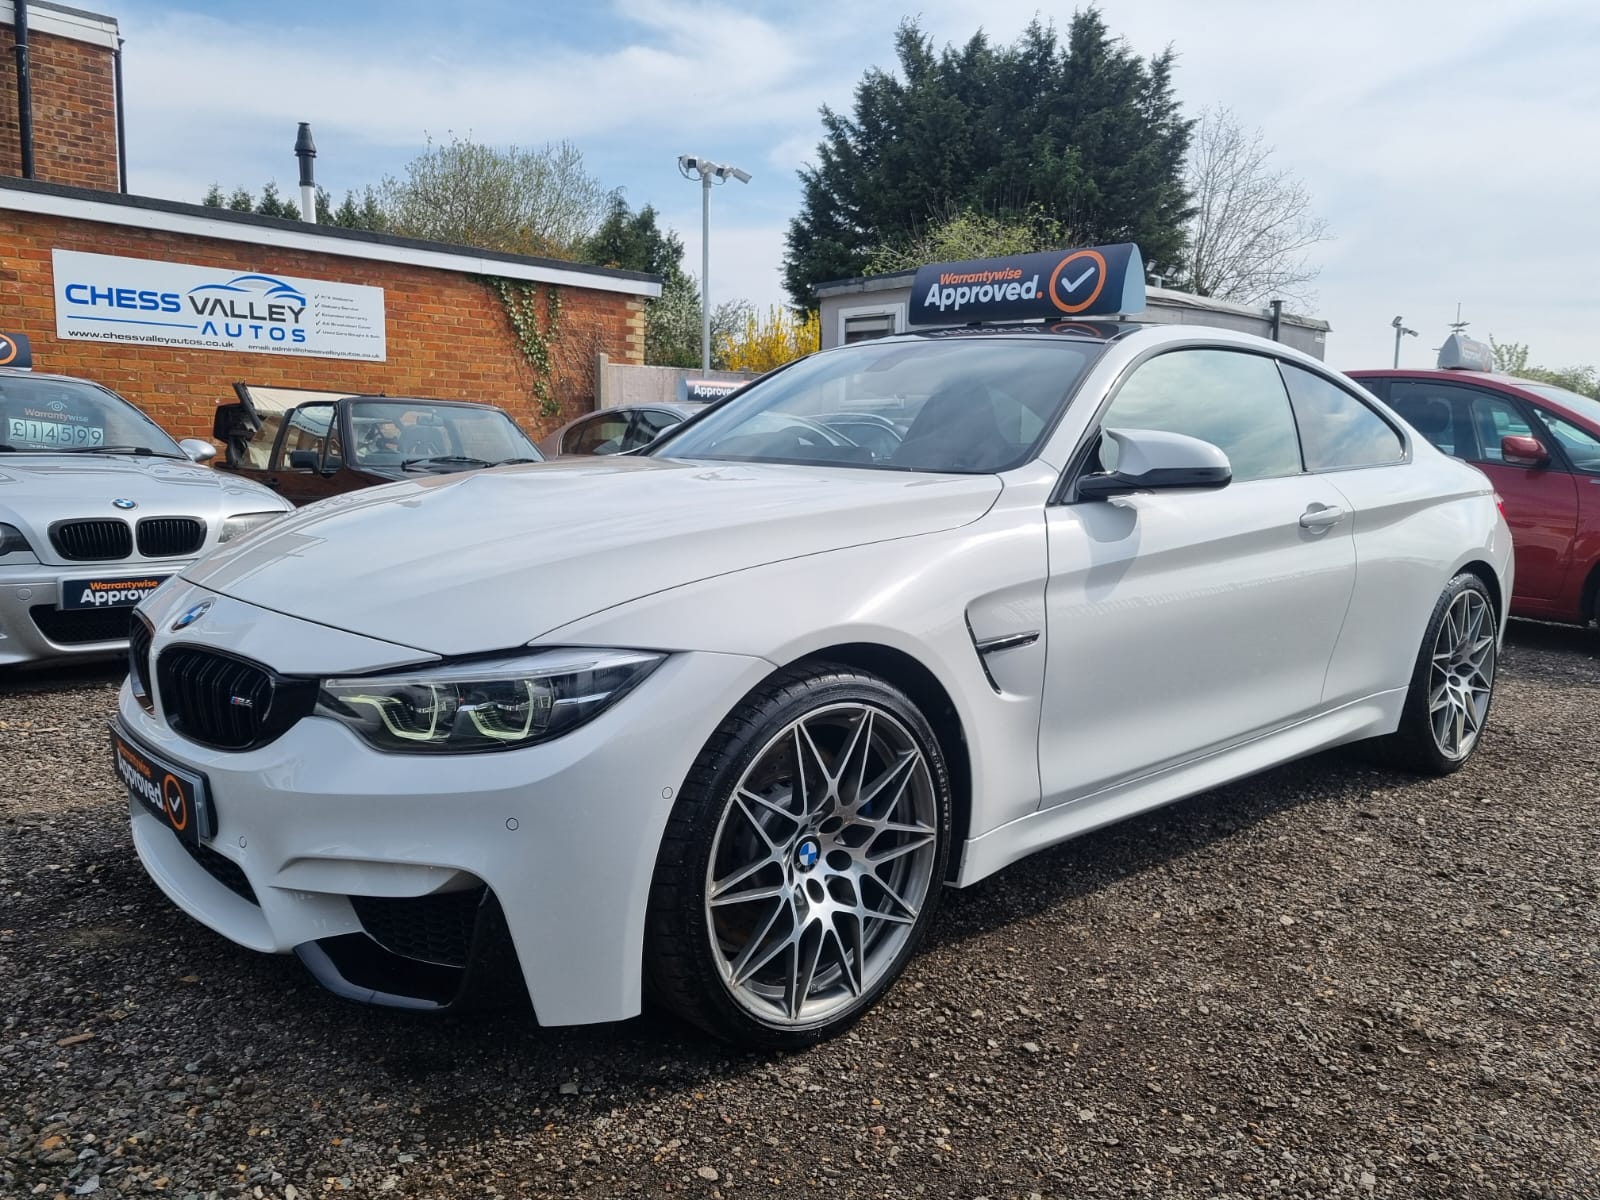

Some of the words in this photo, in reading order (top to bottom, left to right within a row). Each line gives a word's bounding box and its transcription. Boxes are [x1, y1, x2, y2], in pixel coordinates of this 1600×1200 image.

[939, 267, 1022, 285] Warrantywise
[924, 274, 1043, 311] Approved.
[65, 284, 181, 312] CHESS
[188, 295, 305, 324] VALLEY
[68, 329, 234, 349] www.chessvalleyautos.co.uk
[201, 321, 306, 343] AUTOS
[24, 407, 89, 423] Warrantywise
[12, 421, 102, 445] £14599
[90, 580, 159, 590] Warrantywise
[80, 588, 156, 606] Approv
